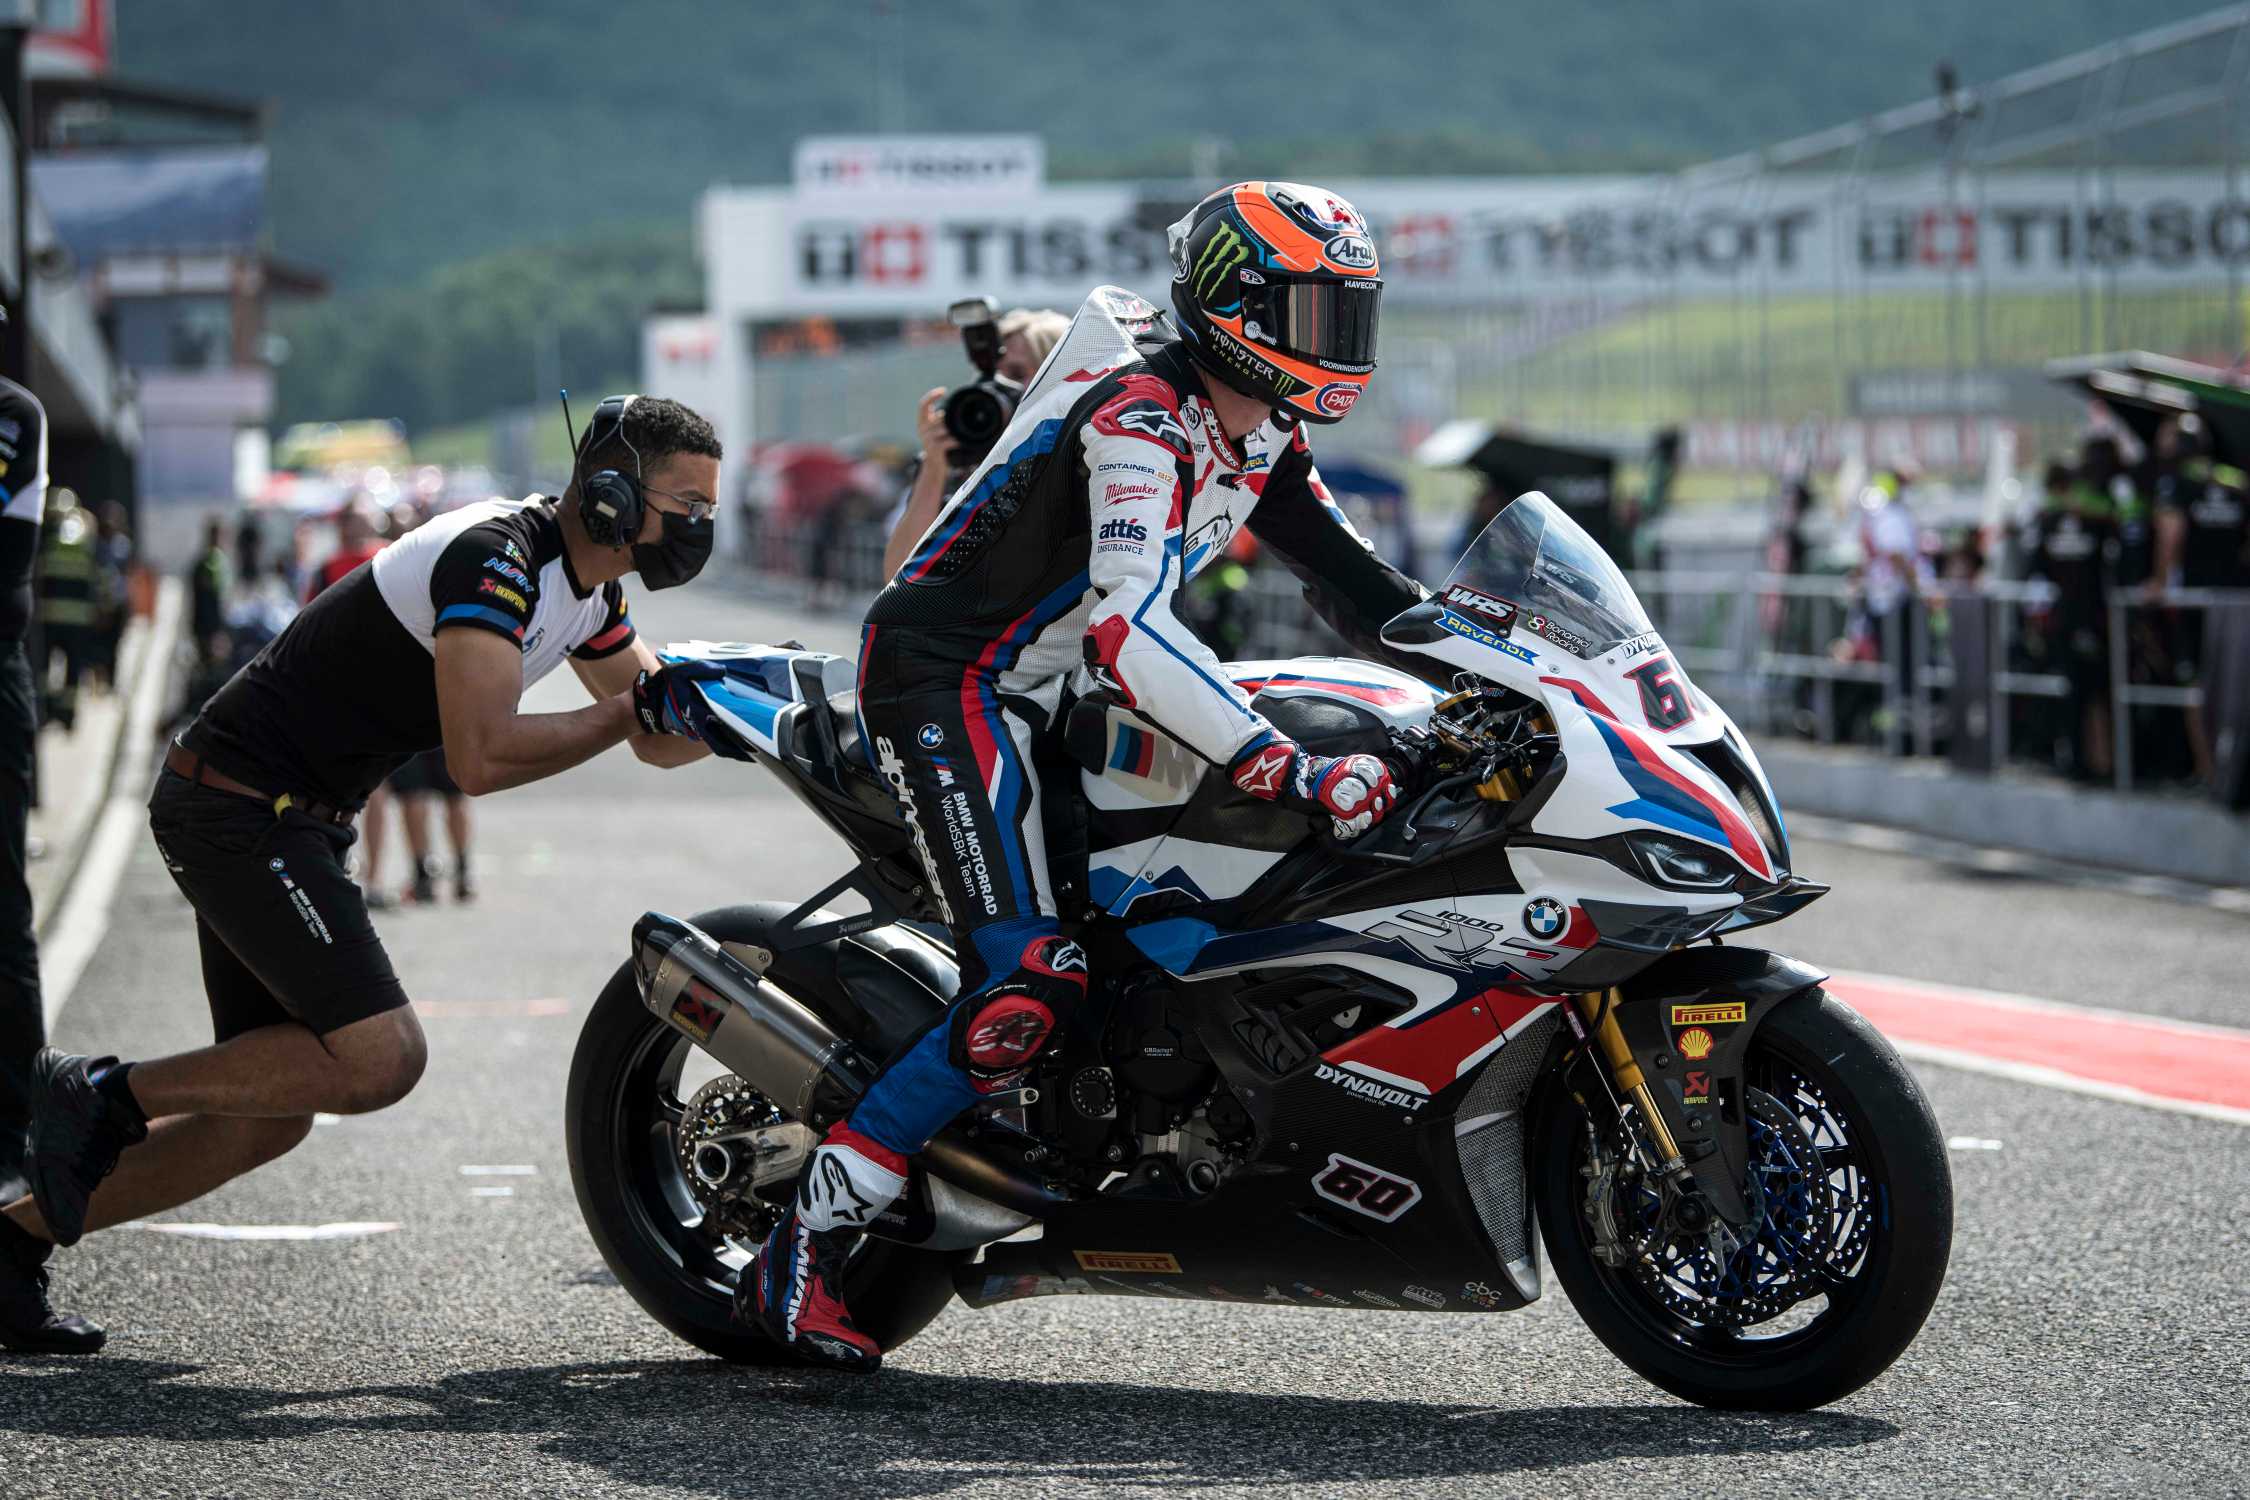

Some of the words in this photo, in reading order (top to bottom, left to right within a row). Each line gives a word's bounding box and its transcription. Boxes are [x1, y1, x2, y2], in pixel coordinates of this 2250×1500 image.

[942, 219, 1158, 284] TISS
[1331, 238, 1374, 260] Arai
[1344, 280, 1377, 290] HAVECON
[1209, 325, 1274, 381] MONSTER
[1212, 344, 1258, 380] ENERGY
[1327, 393, 1356, 407] PATA
[1105, 482, 1160, 503] Milwaukee
[1099, 518, 1148, 541] attis
[1097, 543, 1145, 556] INSURANCE
[1447, 588, 1515, 618] WRS
[1447, 617, 1530, 661] RAVENOL
[1546, 621, 1593, 650] Bonamici
[1546, 632, 1581, 655] Racing
[1622, 655, 1697, 734] 6
[941, 794, 969, 861] WorldSBK
[960, 860, 976, 898] Team
[953, 791, 975, 828] BMW
[965, 830, 998, 916] MOTORRAD
[1527, 899, 1564, 914] BMW
[1436, 910, 1504, 932] 1000
[1675, 1005, 1742, 1022] PIRELLI
[1314, 1063, 1429, 1111] DYNAVOLT
[1318, 1159, 1415, 1217] 60
[1082, 1254, 1172, 1269] PIRELLI
